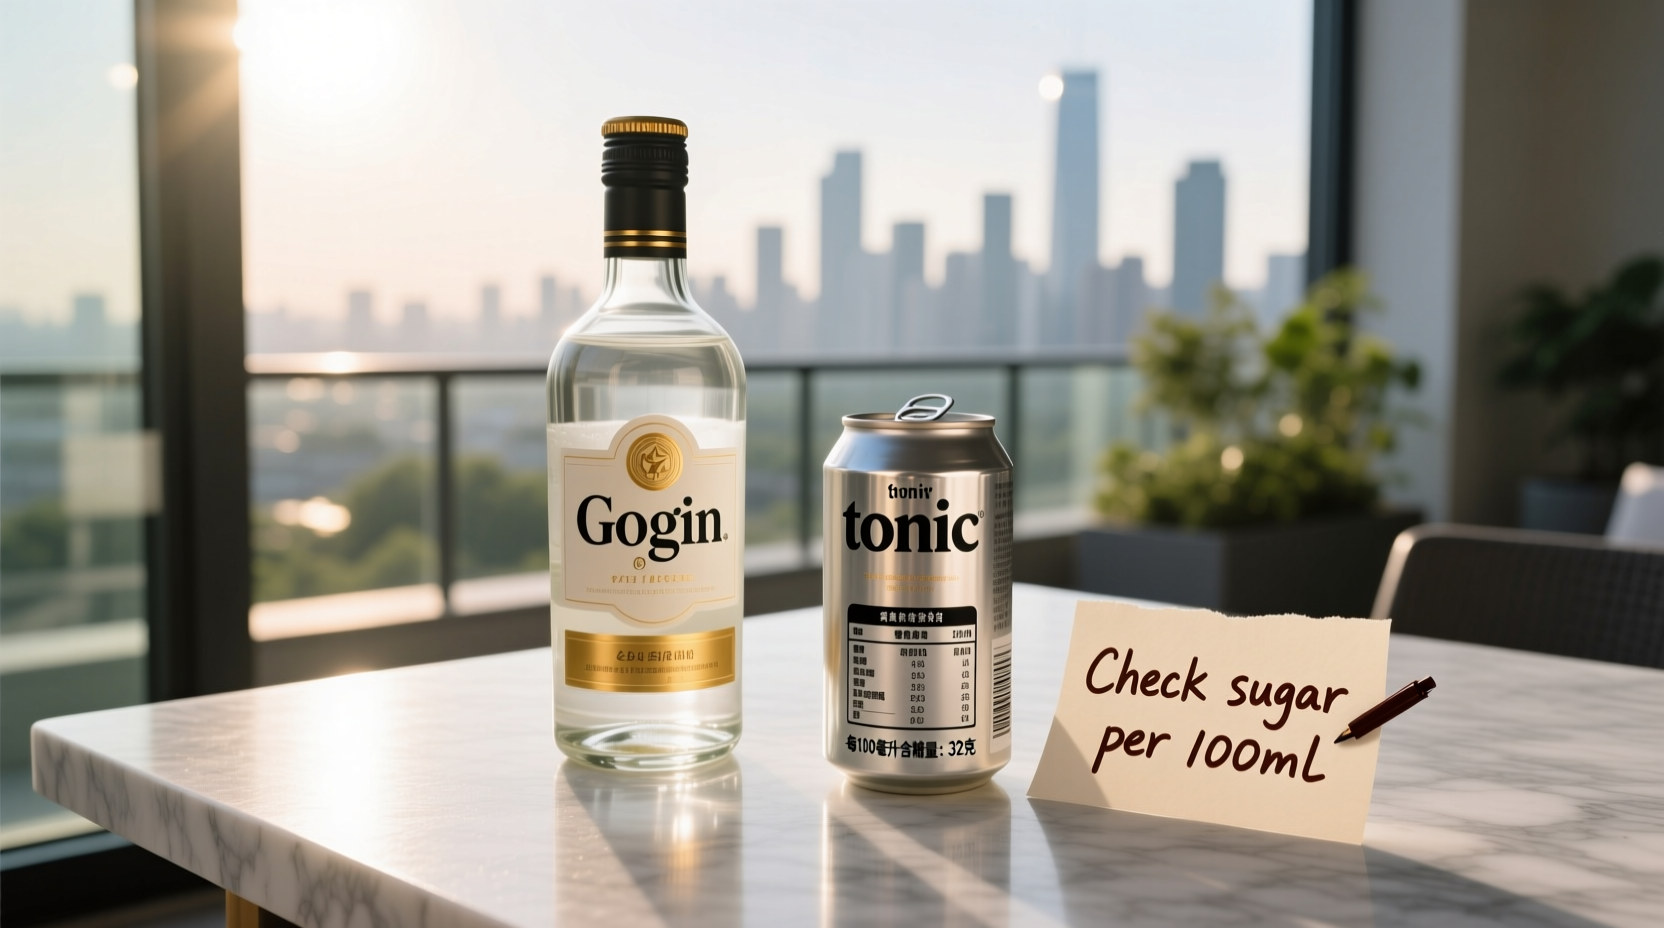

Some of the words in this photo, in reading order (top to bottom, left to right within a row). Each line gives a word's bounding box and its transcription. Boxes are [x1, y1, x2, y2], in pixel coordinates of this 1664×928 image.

[577, 495, 722, 562] Gogin
[843, 499, 979, 552] tonic
[1086, 647, 1208, 702] Check
[1227, 675, 1349, 731] sugar
[1091, 726, 1171, 774] per
[1187, 729, 1325, 783] 100mL
